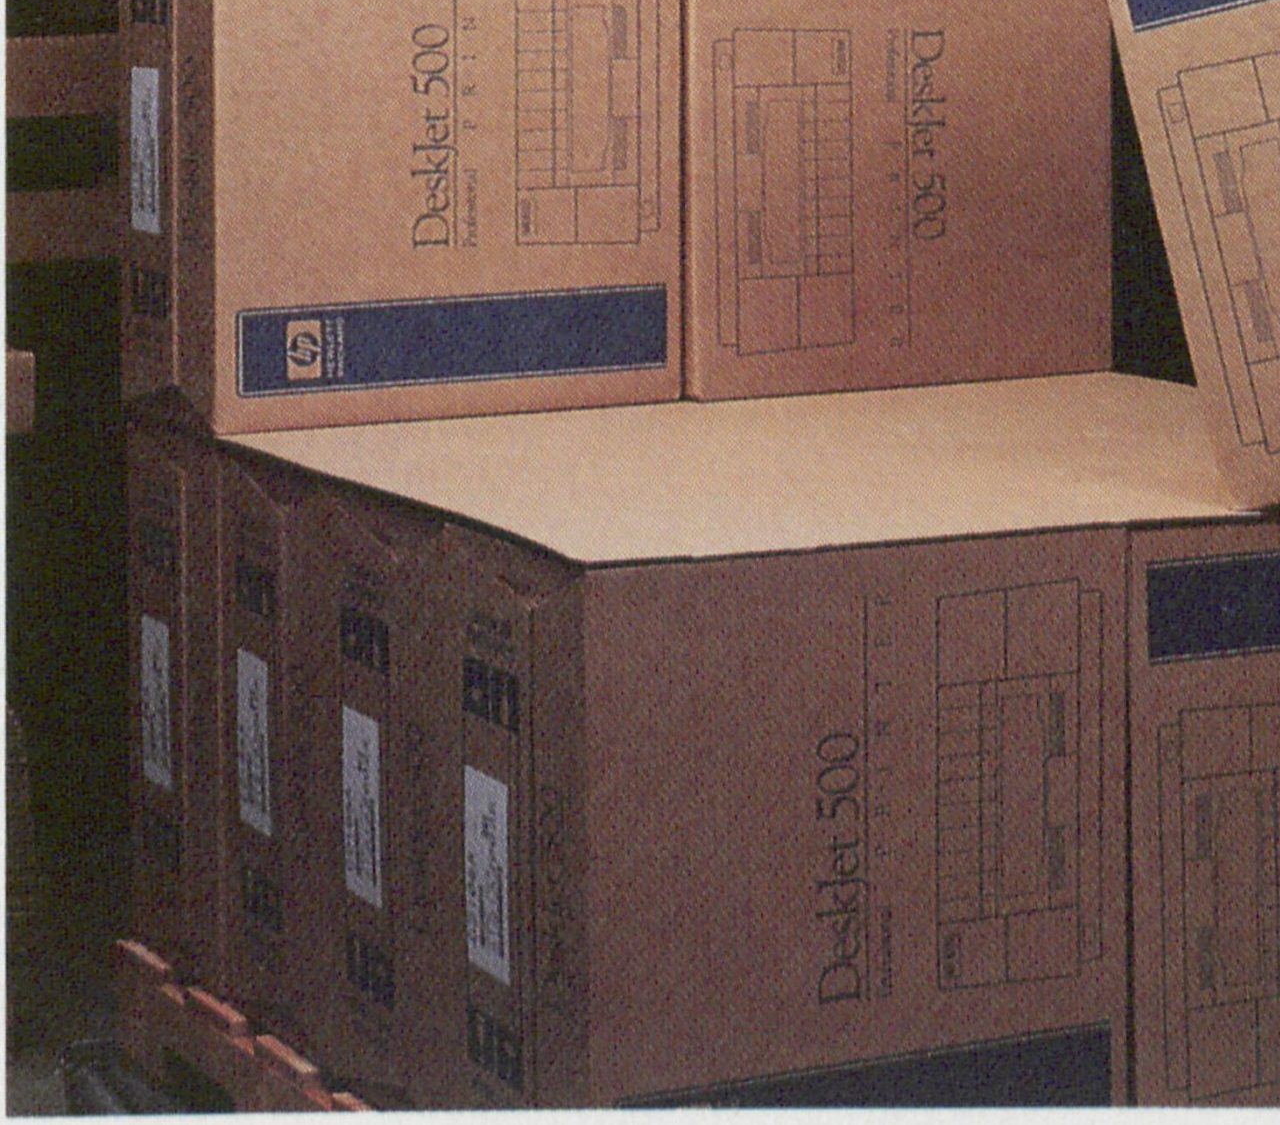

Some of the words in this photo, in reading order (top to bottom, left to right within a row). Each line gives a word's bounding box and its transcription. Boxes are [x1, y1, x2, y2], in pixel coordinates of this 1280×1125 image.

[411, 24, 449, 95] 500
[905, 29, 946, 158] DeskJet
[411, 107, 459, 248] DeskJet
[912, 172, 946, 240] 500
[816, 732, 859, 819] 500
[816, 834, 868, 1003] DeskJet
